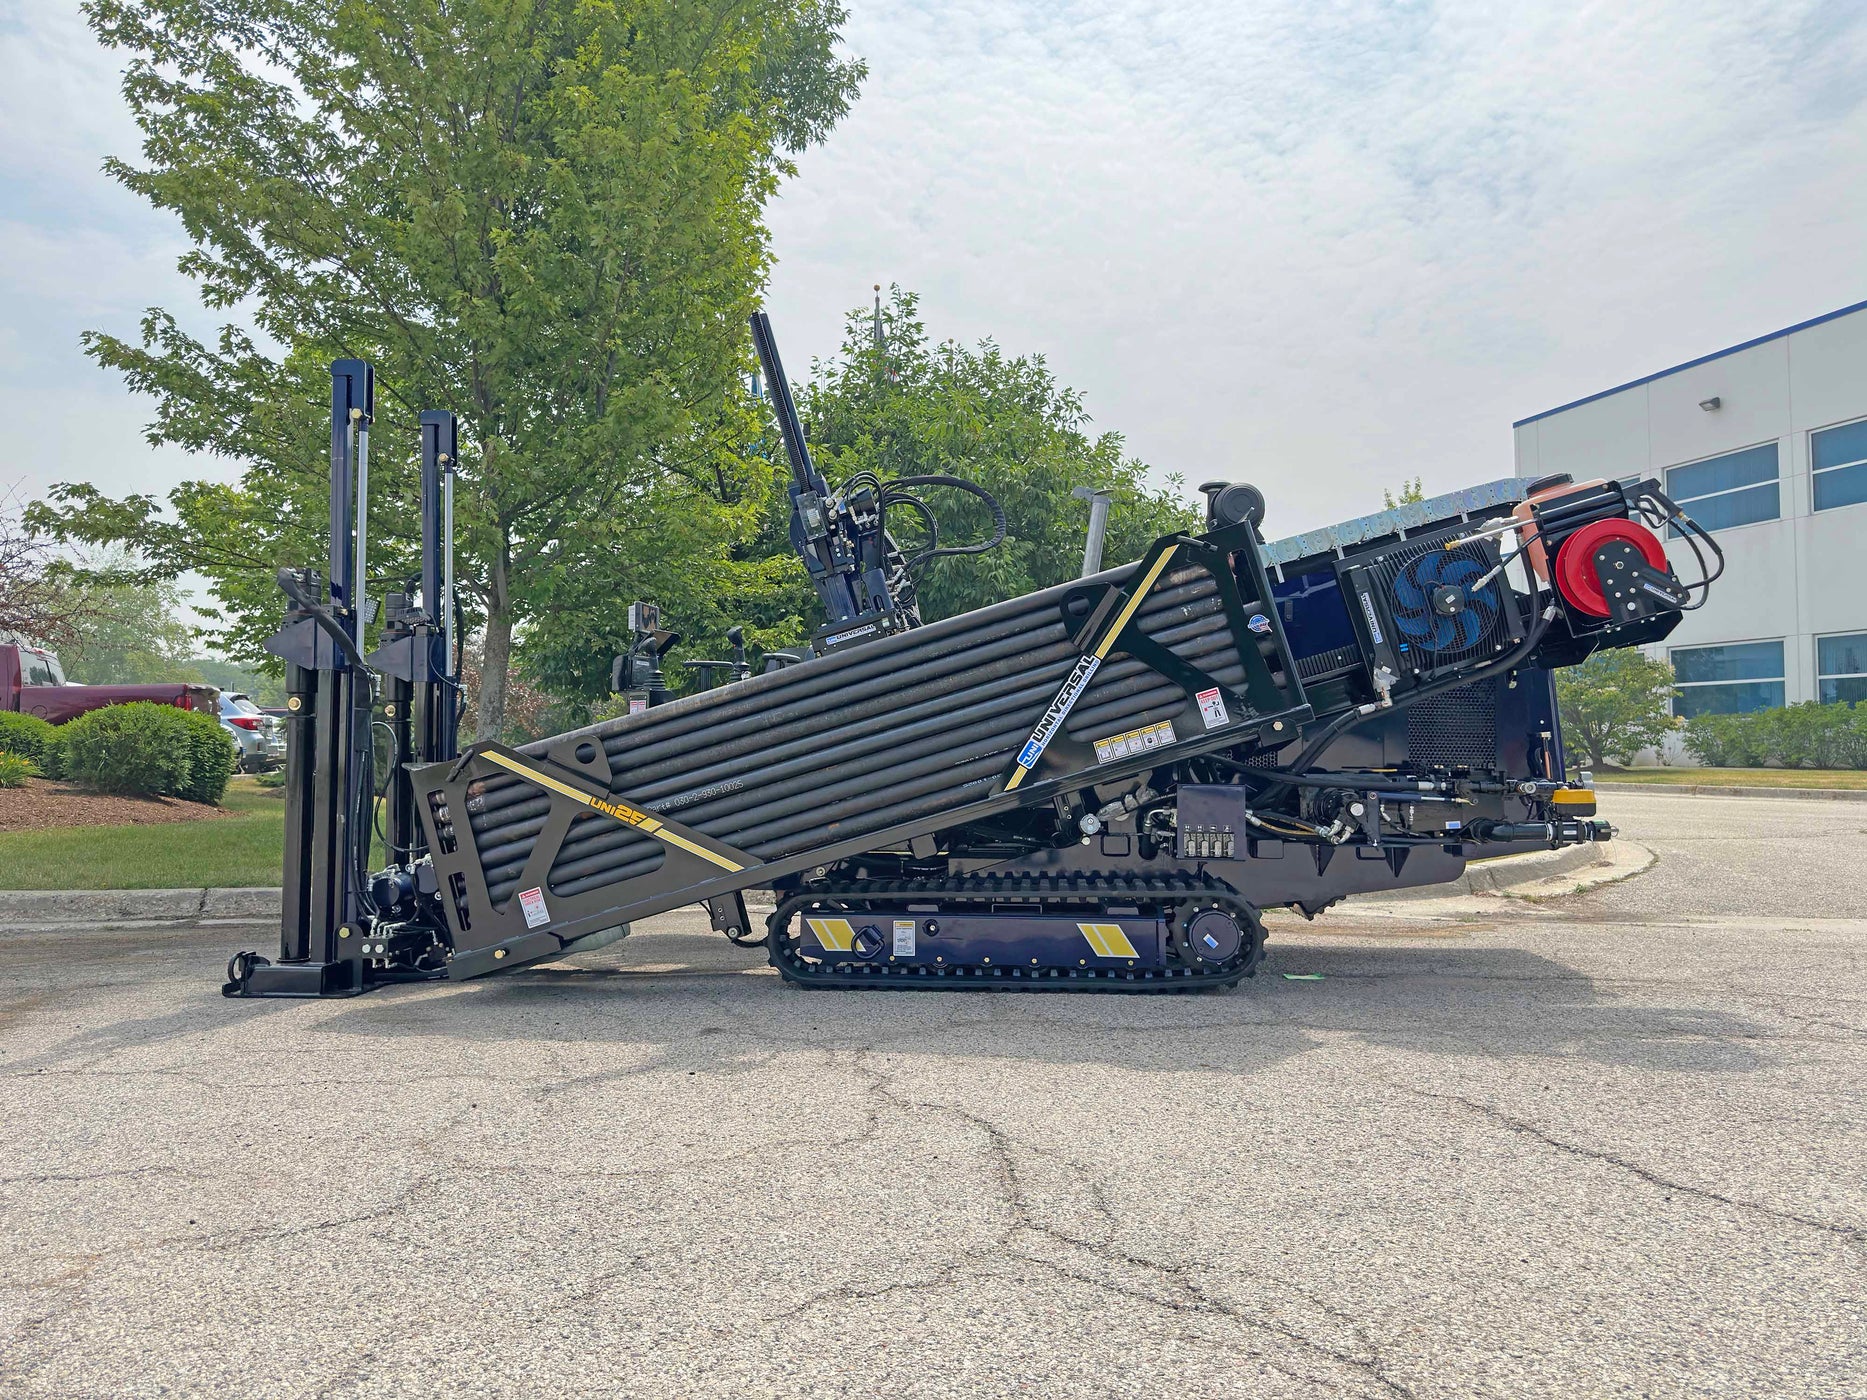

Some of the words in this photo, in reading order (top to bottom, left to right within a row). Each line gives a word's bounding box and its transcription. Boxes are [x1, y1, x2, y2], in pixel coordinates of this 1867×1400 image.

[836, 624, 875, 640] UNIVERSAL
[1031, 654, 1096, 743] UNIVERSAL
[1041, 715, 1063, 747] HORIZONTAL
[673, 779, 744, 807] 030-2-930-10025
[590, 795, 648, 826] UNI25
